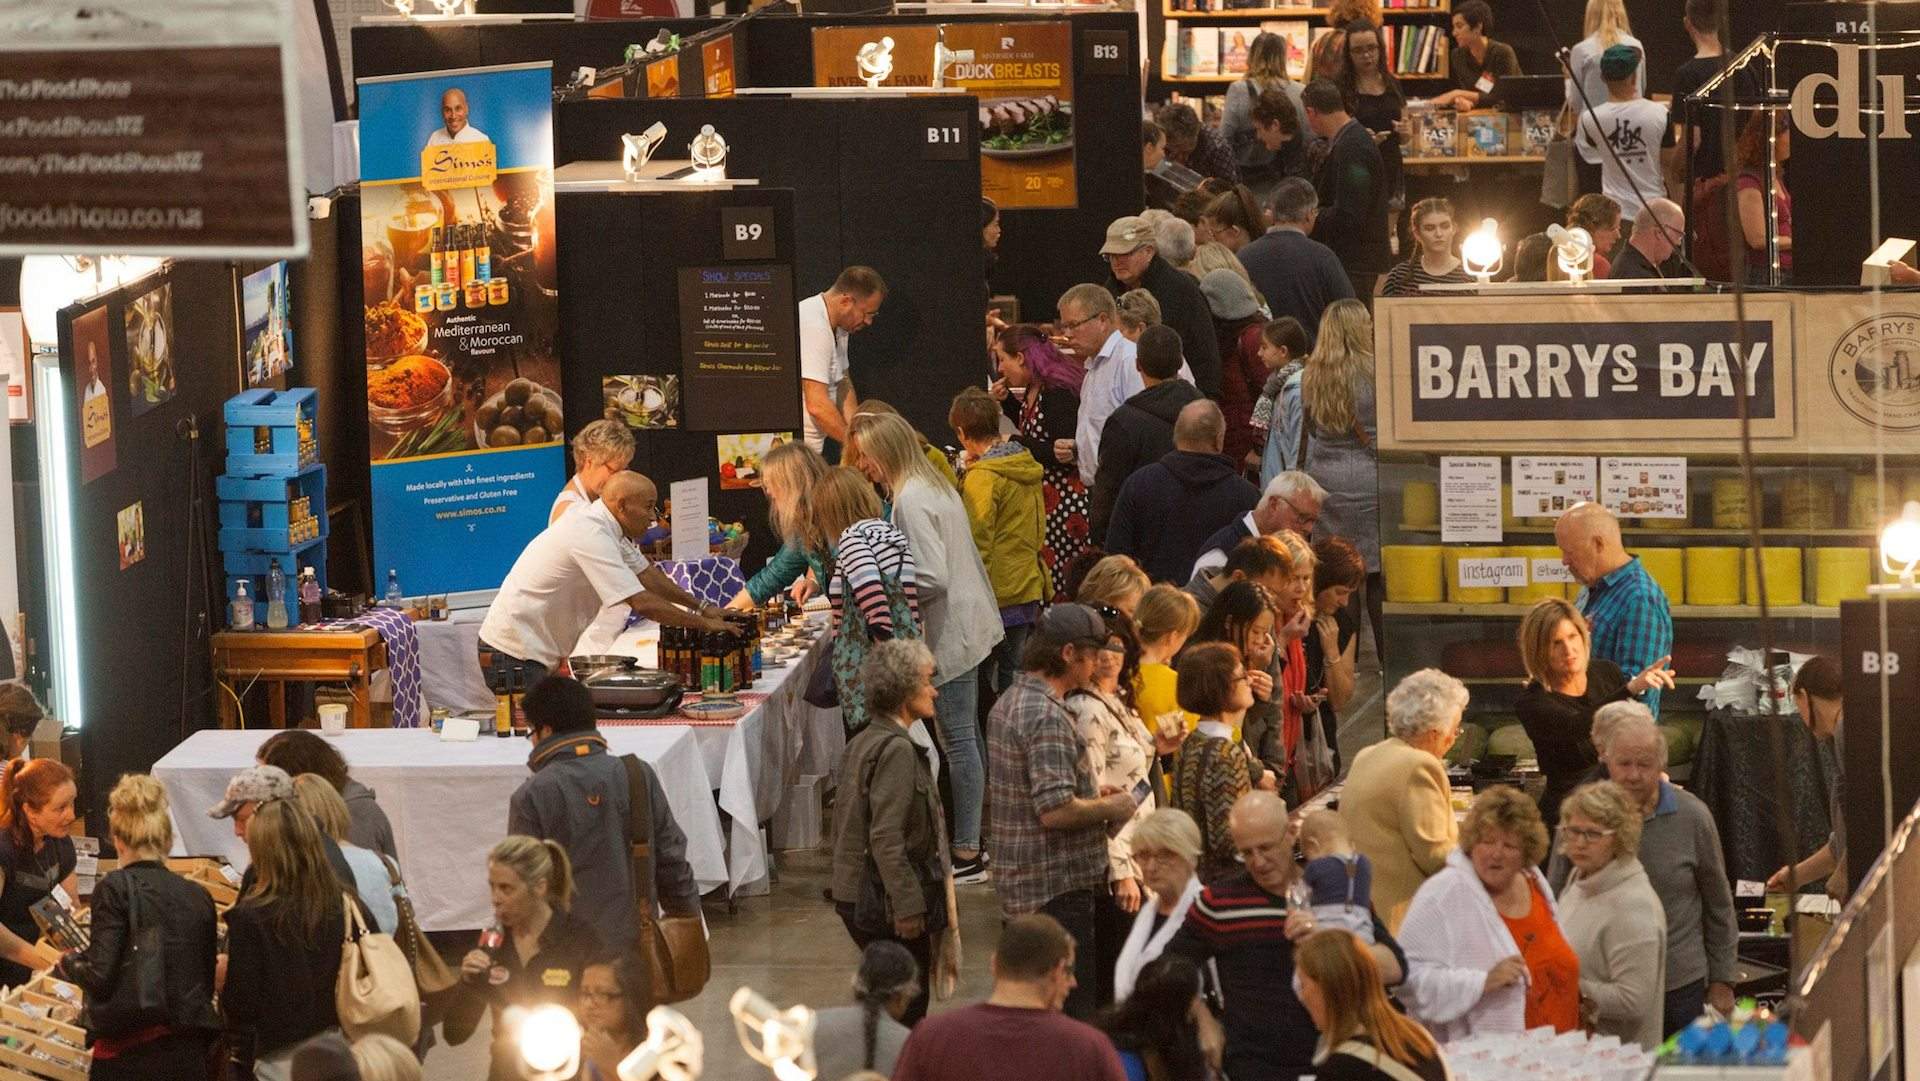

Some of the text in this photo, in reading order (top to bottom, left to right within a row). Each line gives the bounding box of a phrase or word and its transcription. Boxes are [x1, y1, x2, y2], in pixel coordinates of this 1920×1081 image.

[1094, 45, 1118, 59] B13
[894, 75, 928, 87] FARM
[927, 127, 960, 143] B11
[1423, 128, 1454, 139] FAST
[1025, 176, 1041, 190] 20
[735, 223, 762, 241] B9
[446, 315, 476, 324] Authentic
[434, 322, 511, 338] Mediterranean
[470, 334, 523, 348] Moroccan
[470, 348, 496, 356] flavours
[1418, 342, 1767, 399] BARRYS BAY
[406, 471, 535, 492] Made locally with the finest ingredients
[424, 488, 518, 505] Preservative and Gluten Free
[436, 505, 507, 520] www.simos.co.nz
[1463, 562, 1524, 585] instagram
[1862, 650, 1900, 675] B8
